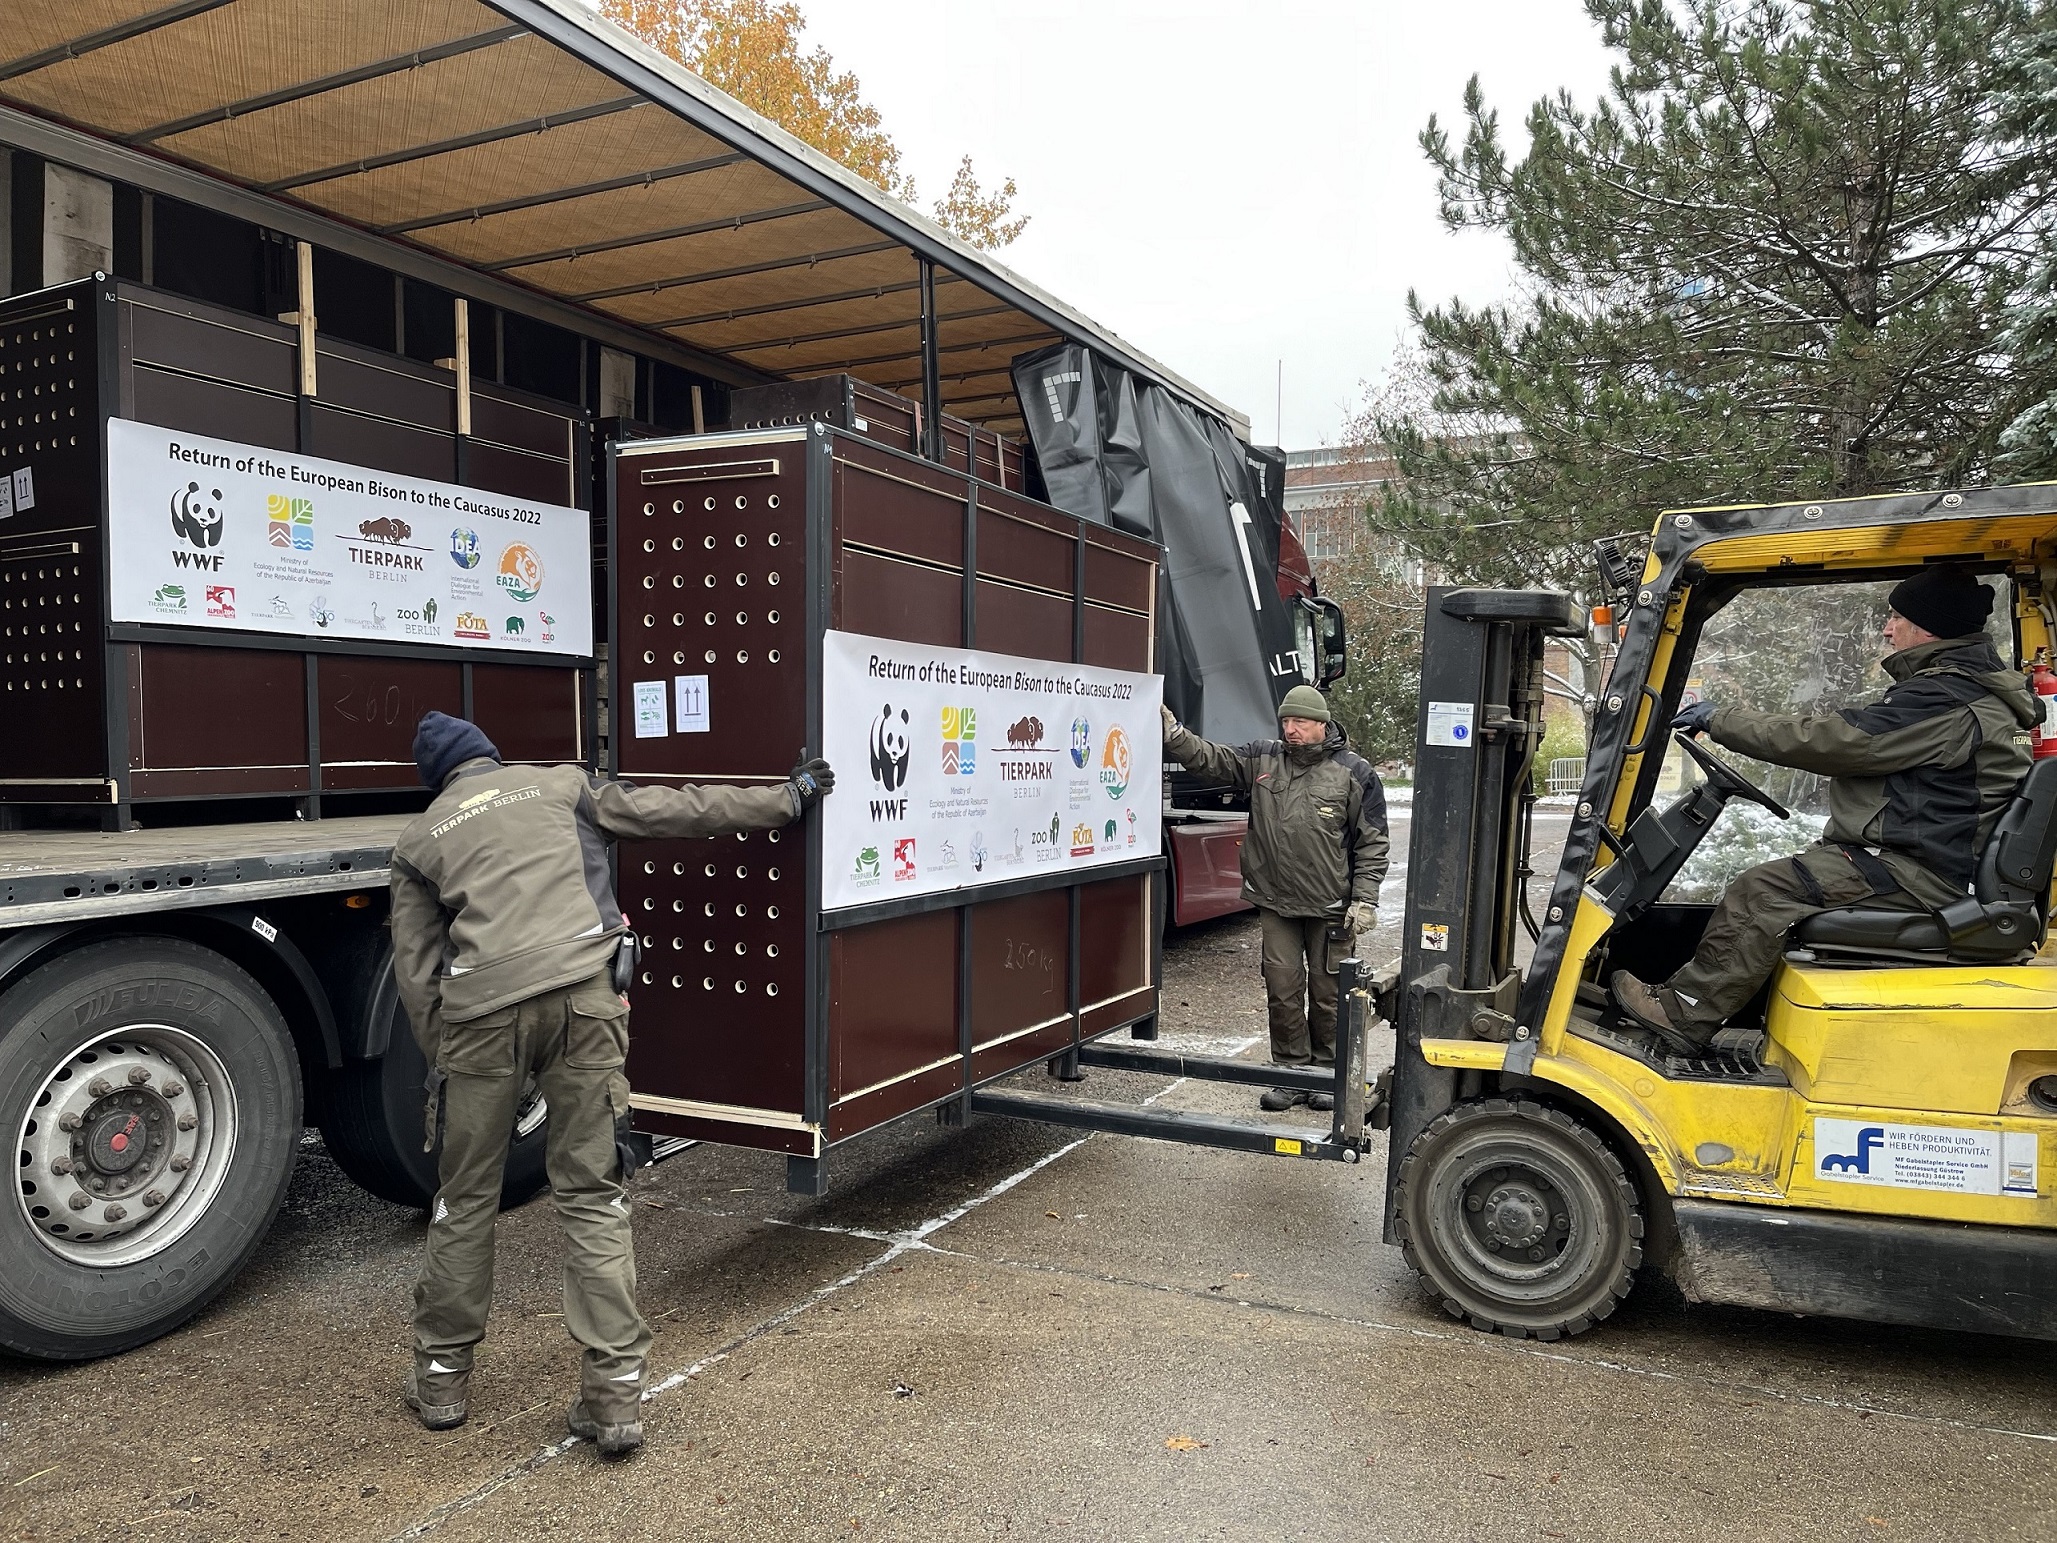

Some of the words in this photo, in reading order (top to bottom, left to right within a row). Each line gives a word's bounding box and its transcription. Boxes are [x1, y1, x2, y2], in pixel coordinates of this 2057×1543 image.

[169, 442, 230, 470] Return
[235, 457, 255, 473] of
[258, 460, 286, 479] the
[290, 465, 364, 493] European
[368, 480, 407, 501] Bison
[411, 490, 425, 504] to
[428, 492, 451, 509] the
[454, 496, 510, 520] Caucasus
[513, 508, 541, 525] 2022
[172, 550, 225, 572] WWF
[280, 556, 300, 566] Ministry
[302, 558, 309, 566] of
[348, 547, 424, 571] TIERPARK
[253, 562, 275, 573] Ecology
[276, 564, 287, 572] and
[288, 566, 307, 575] Natural
[308, 567, 334, 577] Resources
[264, 571, 273, 579] the
[274, 573, 297, 583] Republic
[304, 576, 332, 586] Azerbaijan
[369, 570, 407, 583] BERLIN
[496, 576, 521, 588] EAZA
[148, 600, 178, 609] TIERPARK
[156, 607, 187, 615] CHEMNITZ
[397, 609, 420, 620] ZOO
[456, 616, 488, 630] FOTA
[405, 624, 441, 636] BERLIN
[869, 655, 915, 681] Return
[919, 660, 934, 682] of
[935, 662, 956, 684] the
[960, 665, 1012, 692] European
[1014, 671, 1041, 692] Bison
[1044, 676, 1054, 693] to
[1056, 676, 1072, 695] the
[1074, 678, 1111, 699] Caucasus
[1112, 683, 1132, 700] 2022
[1000, 762, 1053, 781] TIERPARK
[1099, 771, 1117, 783] EAZA
[1013, 787, 1042, 799] BERLIN
[430, 804, 489, 839] TIERPARK
[494, 789, 541, 808] BERLIN
[869, 799, 908, 823] WWF
[1031, 832, 1047, 845] ZOO
[1072, 828, 1093, 846] FOTA
[1036, 847, 1062, 863] BERLIN
[850, 872, 873, 881] TIERPARK
[856, 879, 880, 888] CHEMNITZ
[102, 983, 225, 1027] FULDA
[1889, 1131, 1906, 1140] WIR
[1909, 1133, 1952, 1144] FÖRDERN
[1955, 1137, 1975, 1146] UND
[1889, 1142, 1919, 1151] HEBEN
[1922, 1144, 1992, 1157] PRODUKTIVITÄT.
[1895, 1163, 1938, 1173] Niederlassung
[1939, 1166, 1964, 1175] Güstrow
[1906, 1157, 1945, 1167] Gabelstapler
[1946, 1160, 1969, 1168] Service
[1821, 1171, 1861, 1179] Gabelstapler
[1862, 1174, 1885, 1182] Service
[1895, 1178, 1964, 1189] www.mfgabelstapler.de
